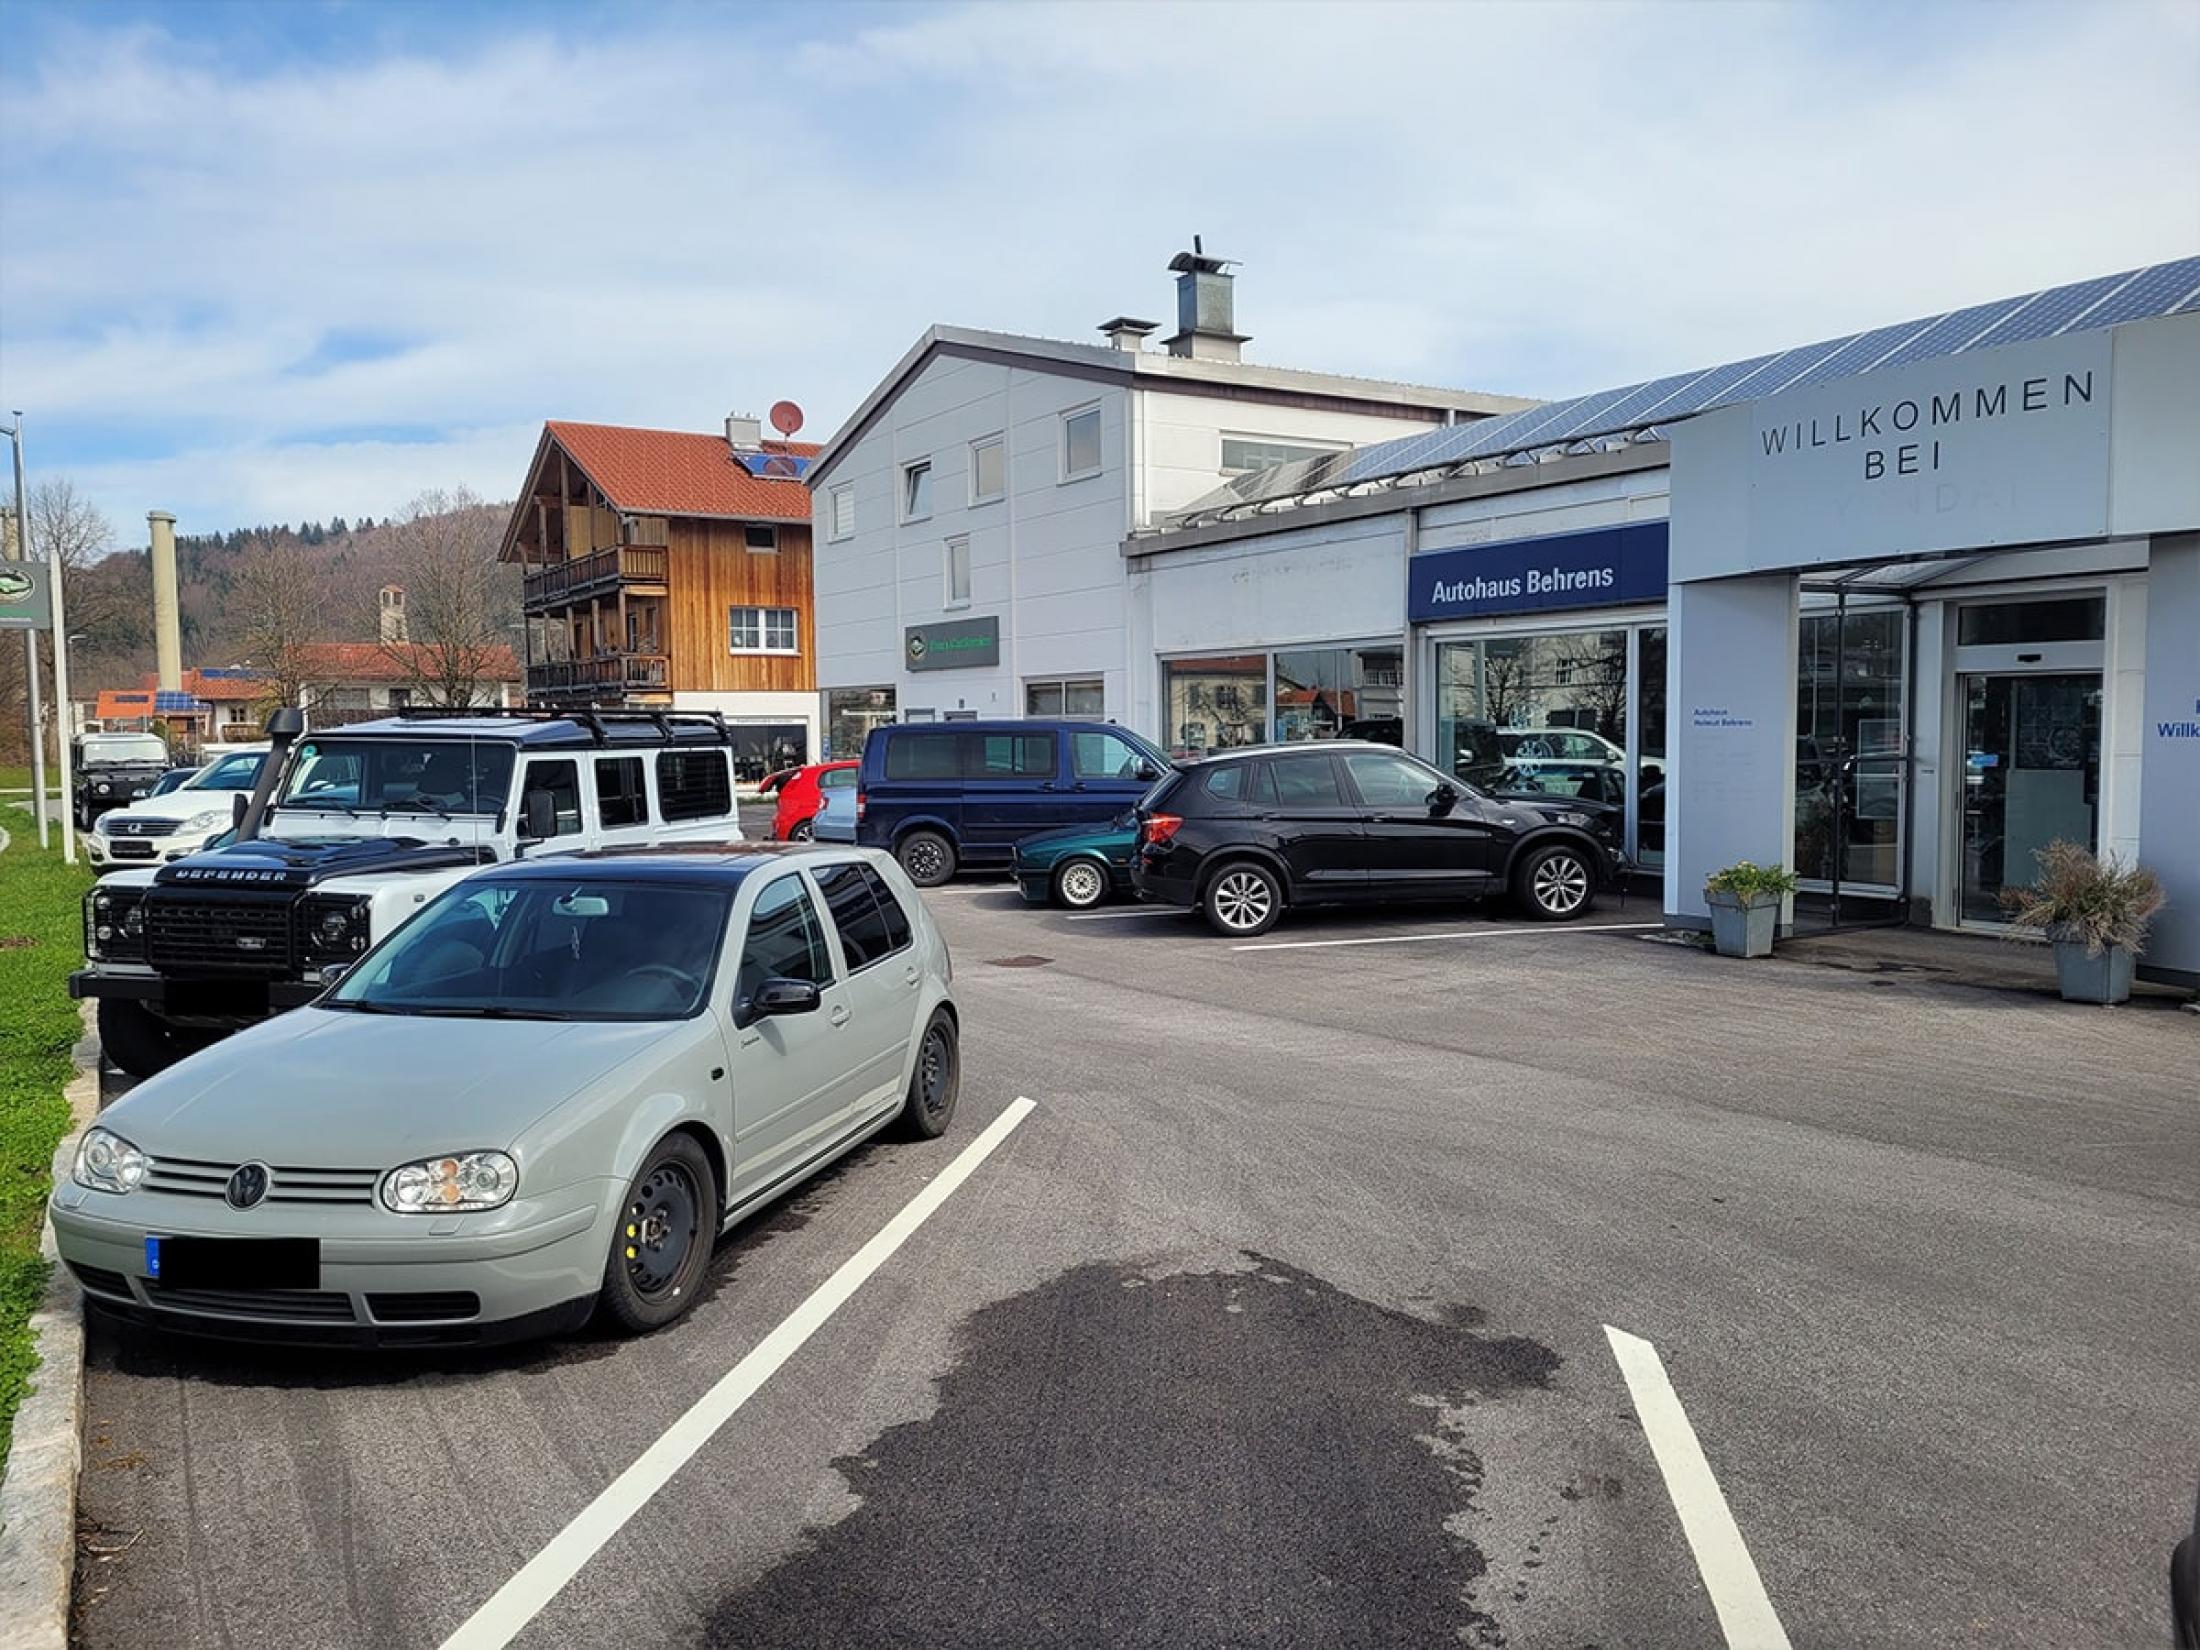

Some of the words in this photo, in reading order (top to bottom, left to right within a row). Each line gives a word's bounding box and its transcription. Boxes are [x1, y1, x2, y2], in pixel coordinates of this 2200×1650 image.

[1761, 370, 2093, 456] WILLKOMMEN
[1865, 441, 1940, 480] BEI
[1431, 576, 1522, 604] Autohaus
[1526, 566, 1615, 594] Behrens
[176, 870, 287, 881] DEFENDER
